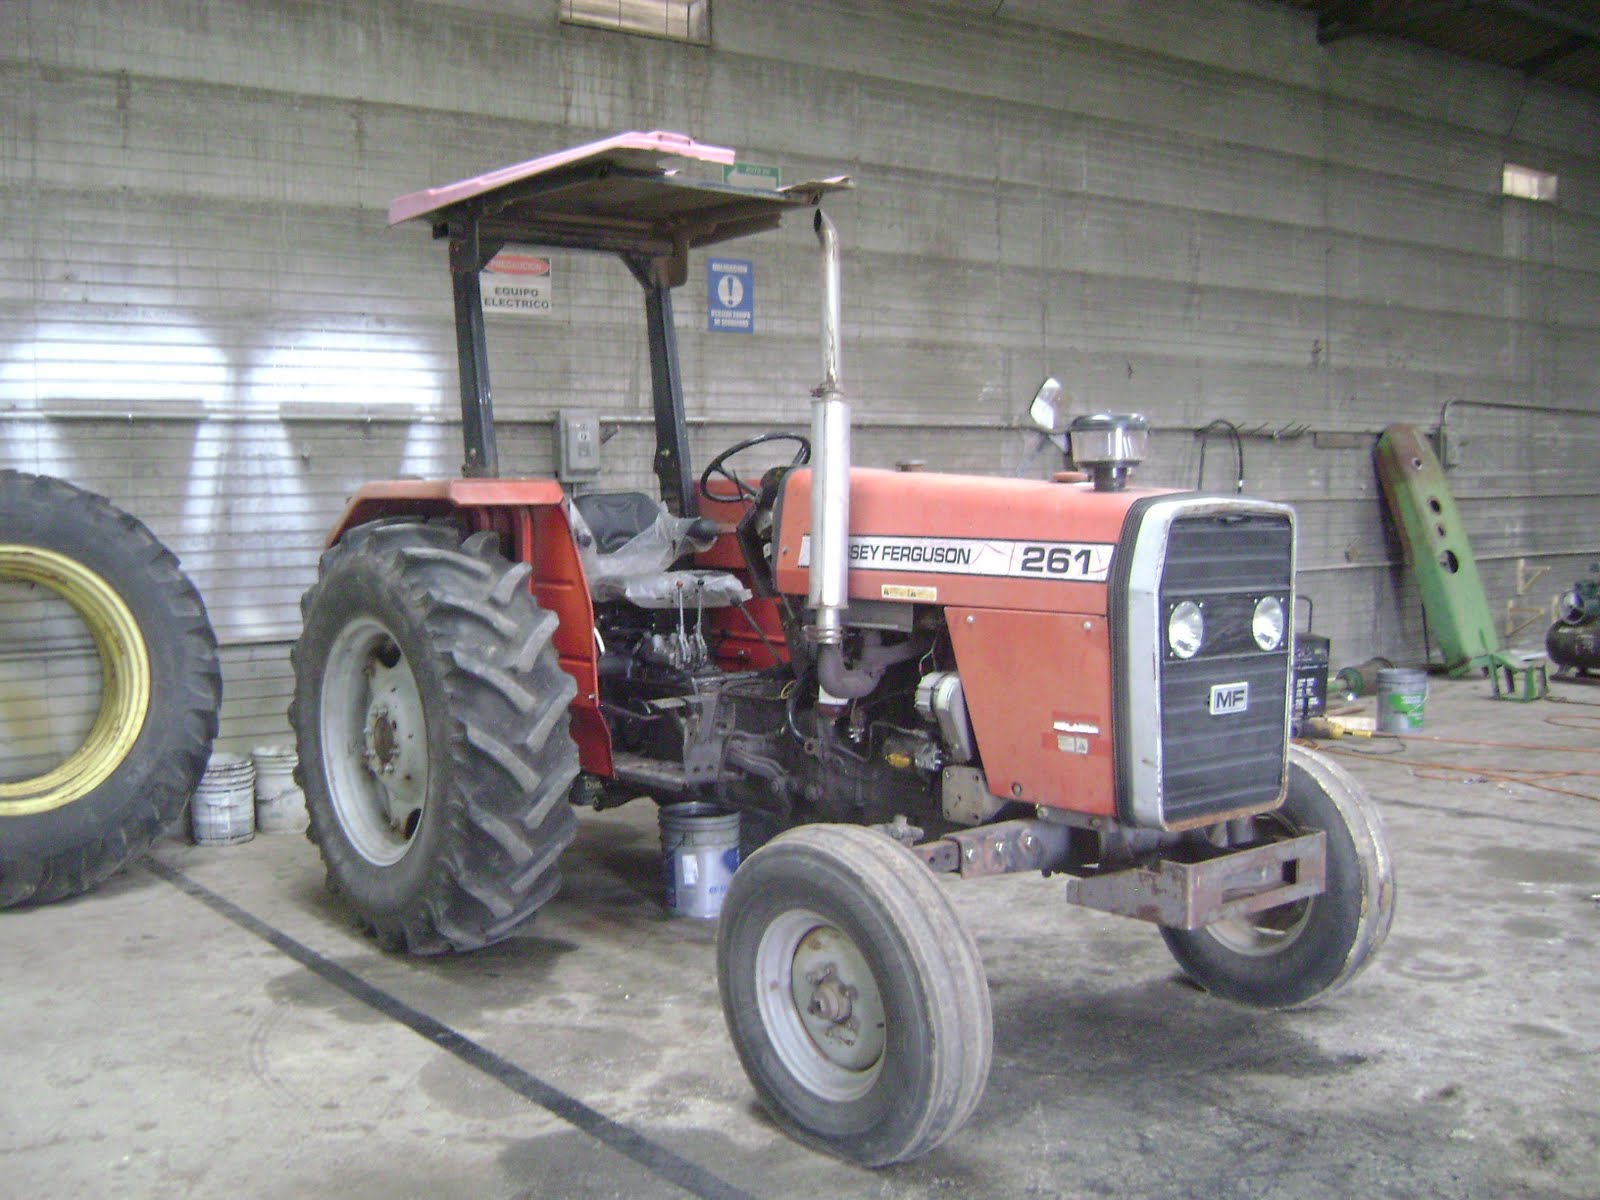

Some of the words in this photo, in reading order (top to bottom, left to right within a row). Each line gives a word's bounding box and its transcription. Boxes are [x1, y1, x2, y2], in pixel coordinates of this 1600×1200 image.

[495, 286, 539, 298] EQUIPO
[484, 298, 549, 310] ELECTRICO
[882, 546, 971, 565] FERGUSON
[1021, 546, 1092, 575] 261
[1216, 690, 1245, 708] MF
